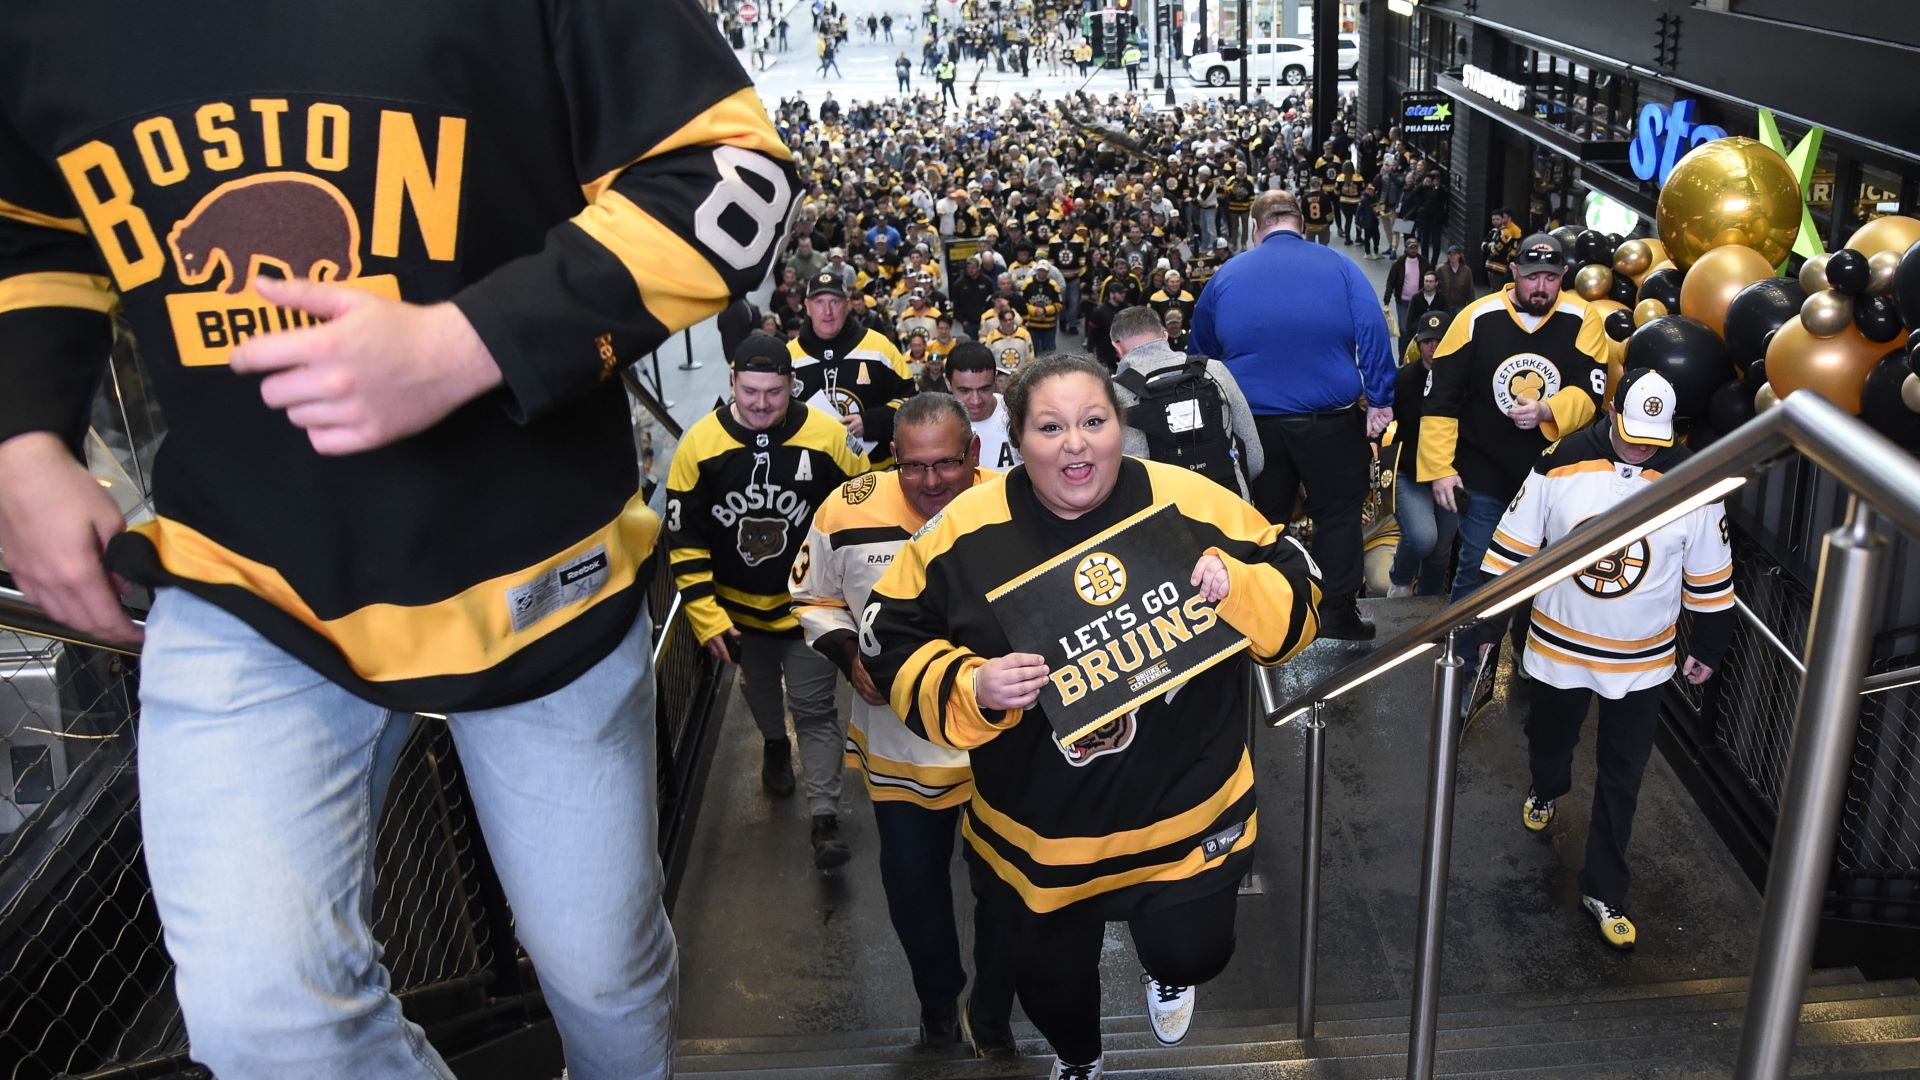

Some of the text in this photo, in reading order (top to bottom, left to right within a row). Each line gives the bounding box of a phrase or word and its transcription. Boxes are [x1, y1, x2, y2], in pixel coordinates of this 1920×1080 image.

[1405, 124, 1451, 133] PHARMACY
[1629, 98, 1728, 192] st
[57, 98, 467, 292] BOSTON
[694, 144, 792, 270] 8
[856, 361, 871, 385] A
[1498, 359, 1557, 385] LETTERKENNY
[794, 449, 813, 481] A
[997, 441, 1015, 468] A
[711, 484, 811, 528] BOSTON
[566, 560, 600, 580] Reebok
[867, 554, 897, 564] RAPI
[858, 602, 882, 658] 8
[1059, 581, 1179, 660] LET'S GO
[1049, 594, 1217, 707] BRUINS
[1135, 665, 1160, 682] BRUINS
